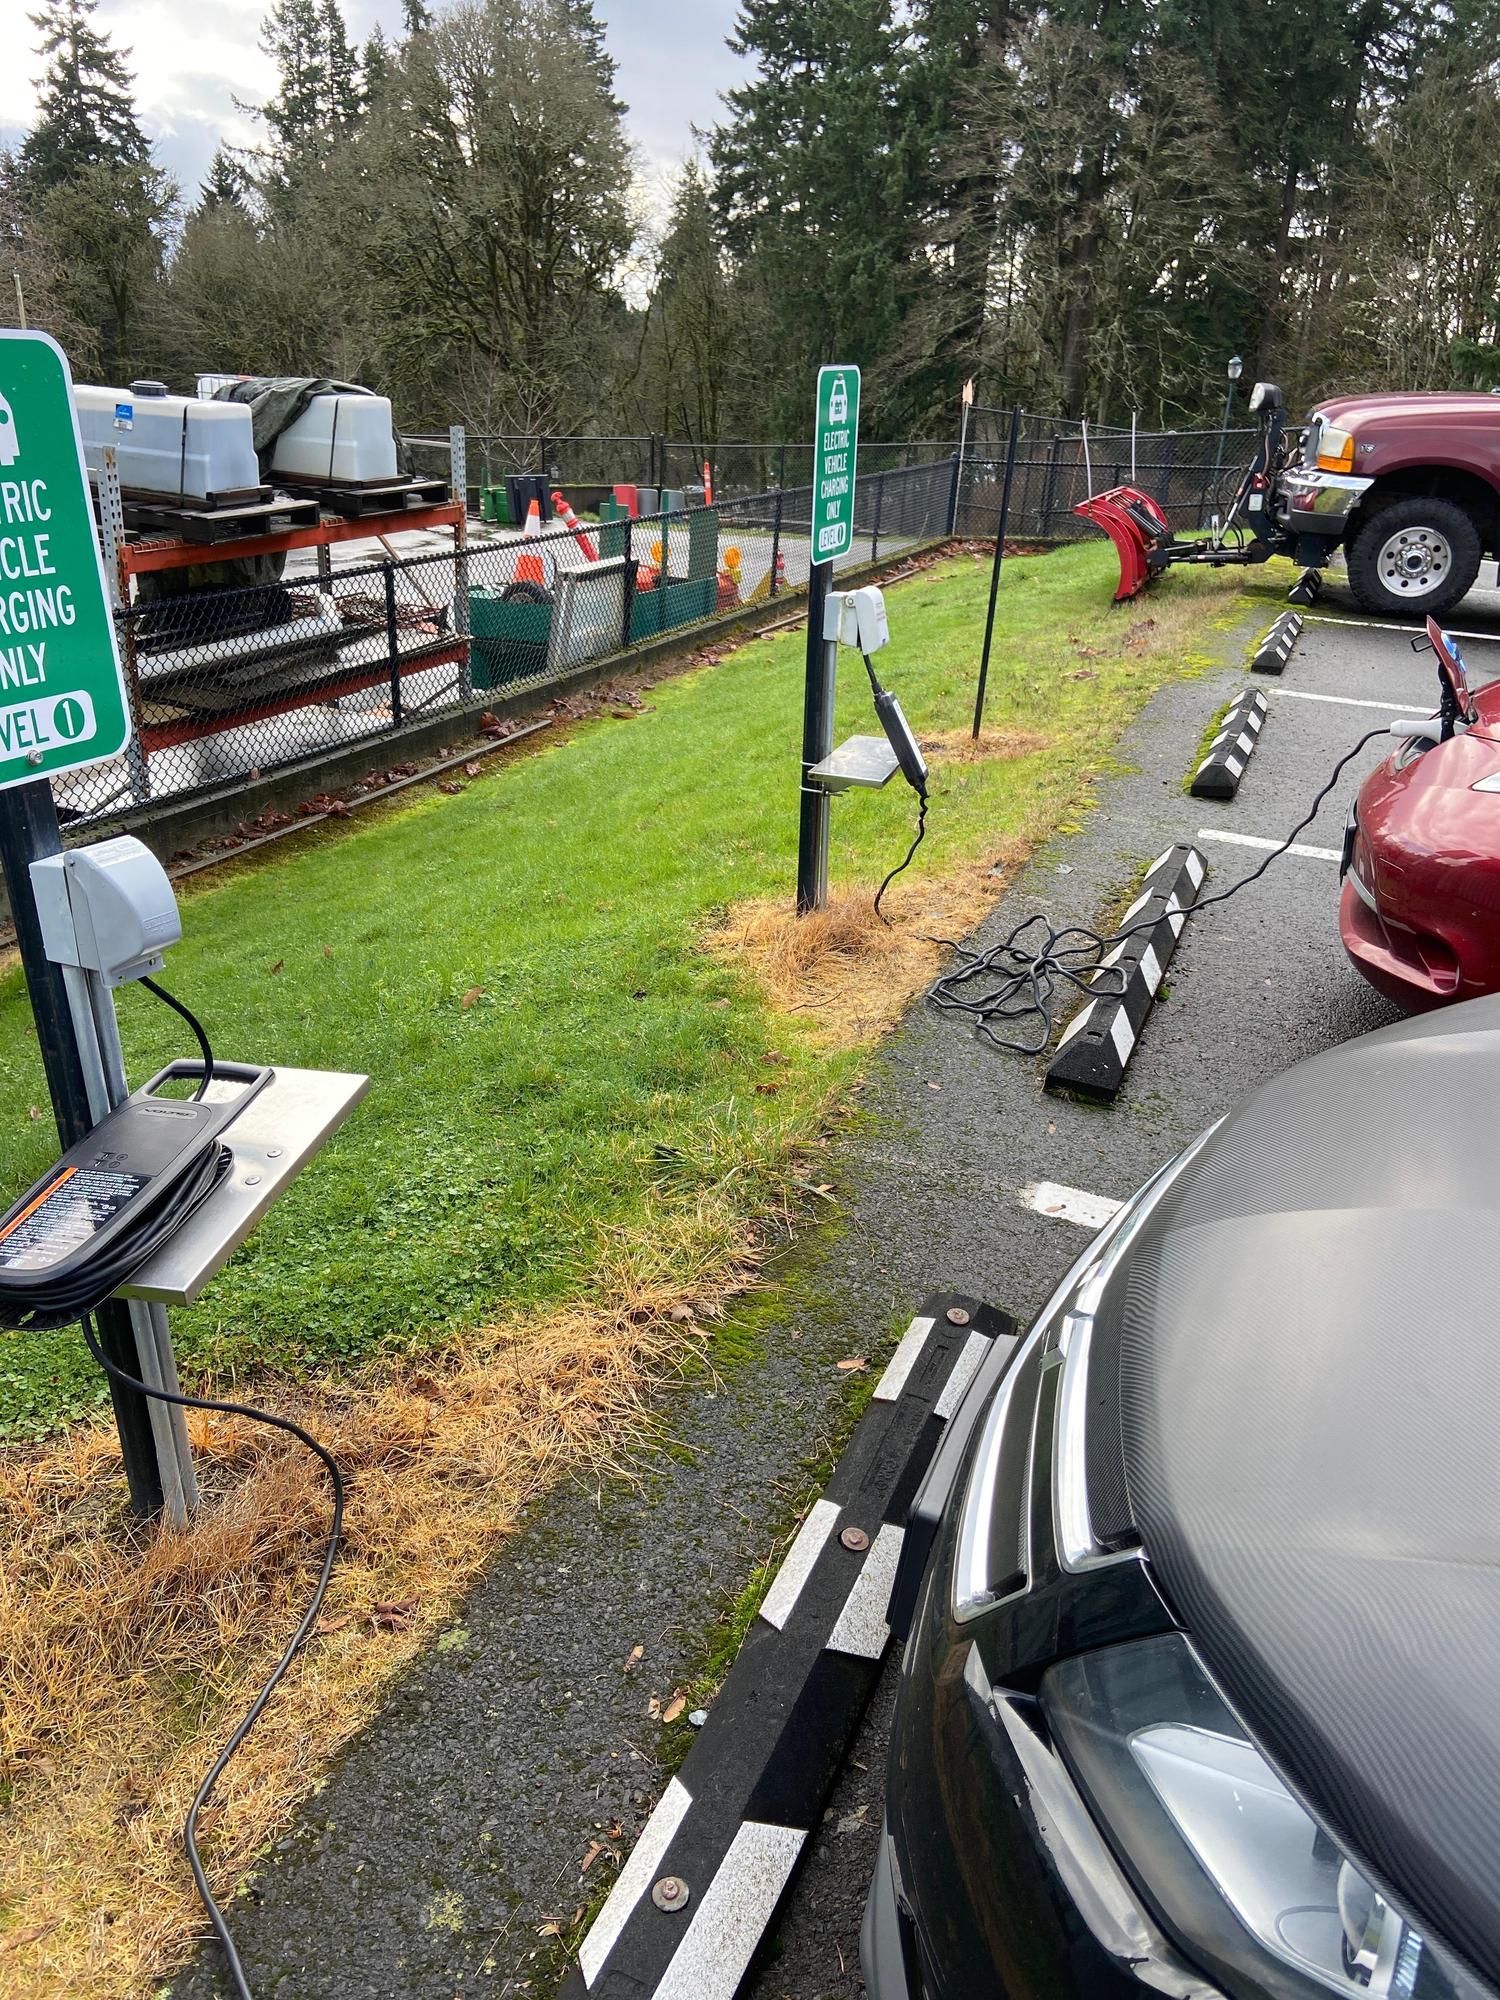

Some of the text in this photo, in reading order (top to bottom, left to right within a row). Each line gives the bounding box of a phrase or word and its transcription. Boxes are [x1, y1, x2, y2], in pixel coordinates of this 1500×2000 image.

[824, 429, 850, 451] ELECTRIC
[825, 453, 847, 474] VEHICLE
[821, 476, 848, 499] CHARGING
[0, 479, 51, 524] RIC
[826, 499, 841, 520] ONLY
[821, 529, 836, 548] LEVEL
[0, 534, 56, 580] CLE
[62, 700, 75, 736] 1
